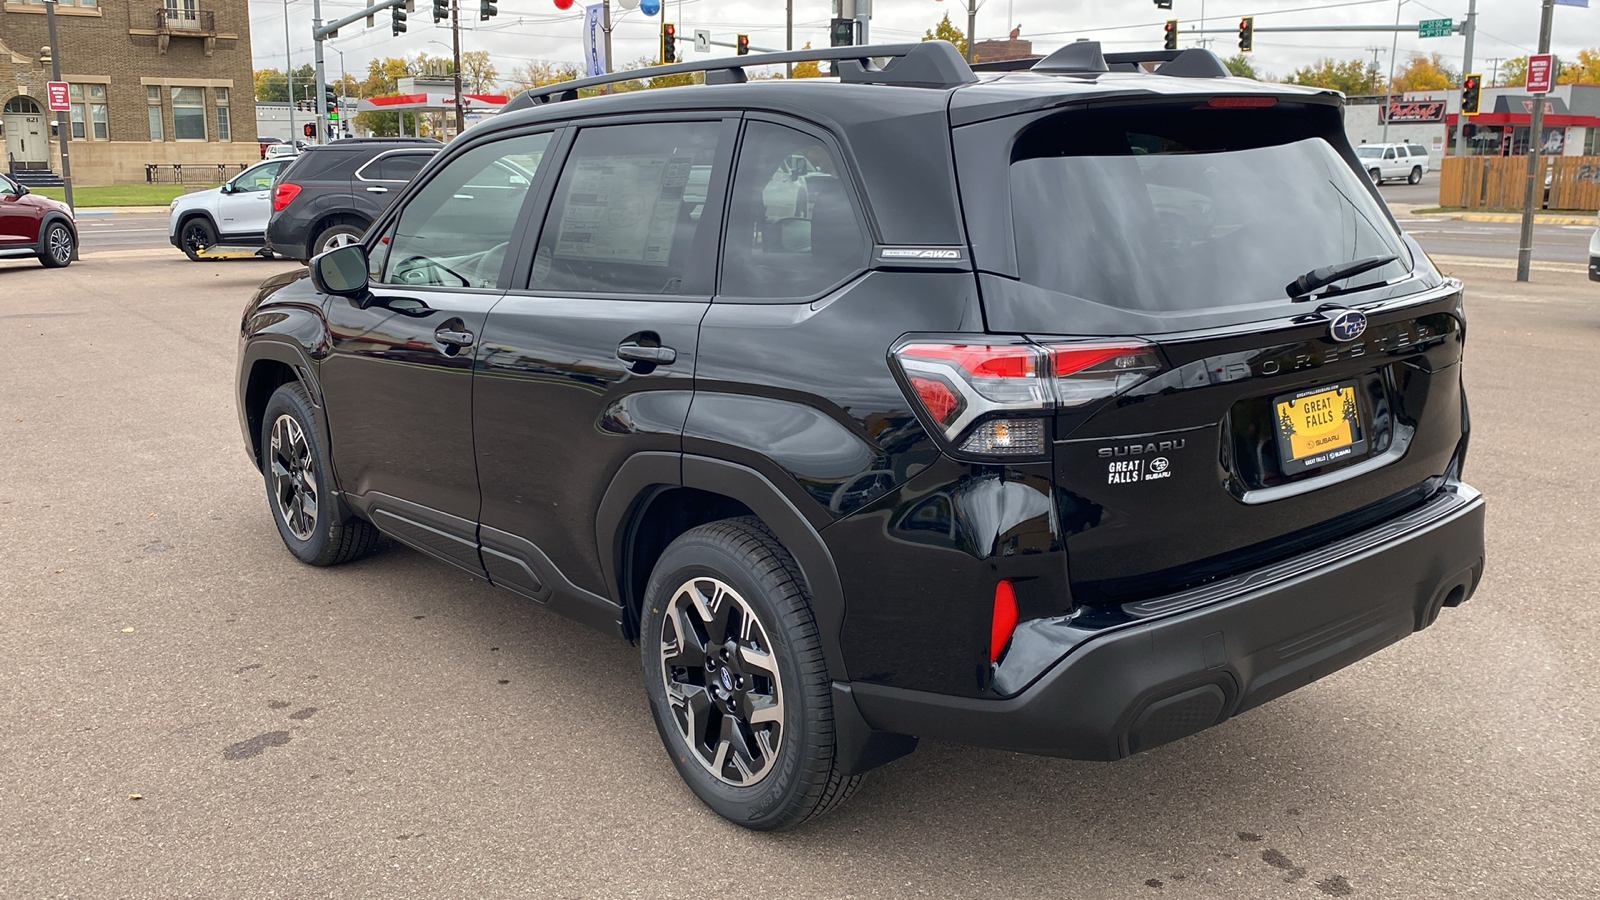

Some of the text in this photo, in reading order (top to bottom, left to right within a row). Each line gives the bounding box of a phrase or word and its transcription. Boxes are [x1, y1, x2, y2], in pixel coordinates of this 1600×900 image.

[919, 250, 958, 258] AWD
[1304, 397, 1331, 414] GREAT
[1305, 410, 1334, 428] FALLS
[1315, 434, 1340, 447] SUBARU
[1098, 438, 1185, 458] SUBARU
[1305, 458, 1316, 466] GREAT
[1335, 448, 1351, 457] SUBARU
[1108, 460, 1140, 473] GREAT
[1107, 471, 1139, 485] FALLS
[1145, 471, 1171, 480] SUBARU
